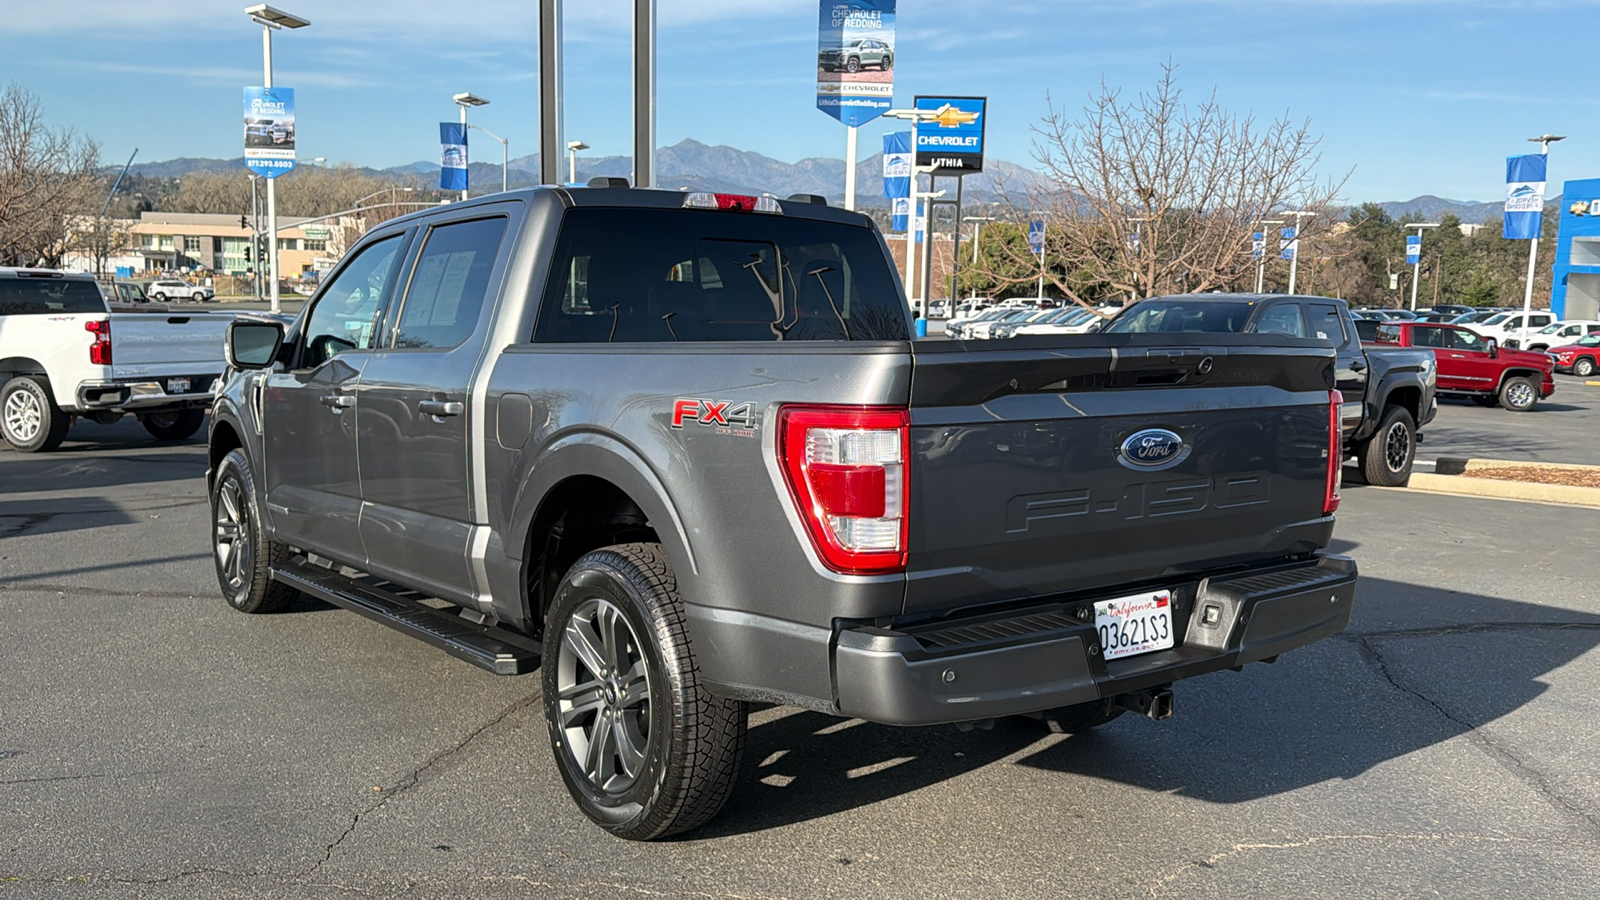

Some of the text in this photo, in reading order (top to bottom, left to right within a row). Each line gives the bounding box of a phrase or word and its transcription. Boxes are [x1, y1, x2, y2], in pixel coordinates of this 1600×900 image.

[832, 9, 882, 19] CHEVROLET
[832, 18, 882, 29] OF REDDING
[251, 101, 285, 109] CHEVROLET
[818, 99, 890, 108] LithiaChevroletRedding.com
[918, 135, 979, 146] CHEVROLET
[671, 397, 758, 430] FX4
[1137, 436, 1172, 458] Ford
[1005, 470, 1272, 533] F-150
[1109, 601, 1157, 618] California
[1099, 613, 1169, 652] 03621S3
[1113, 643, 1155, 656] dmv.ca.gov
